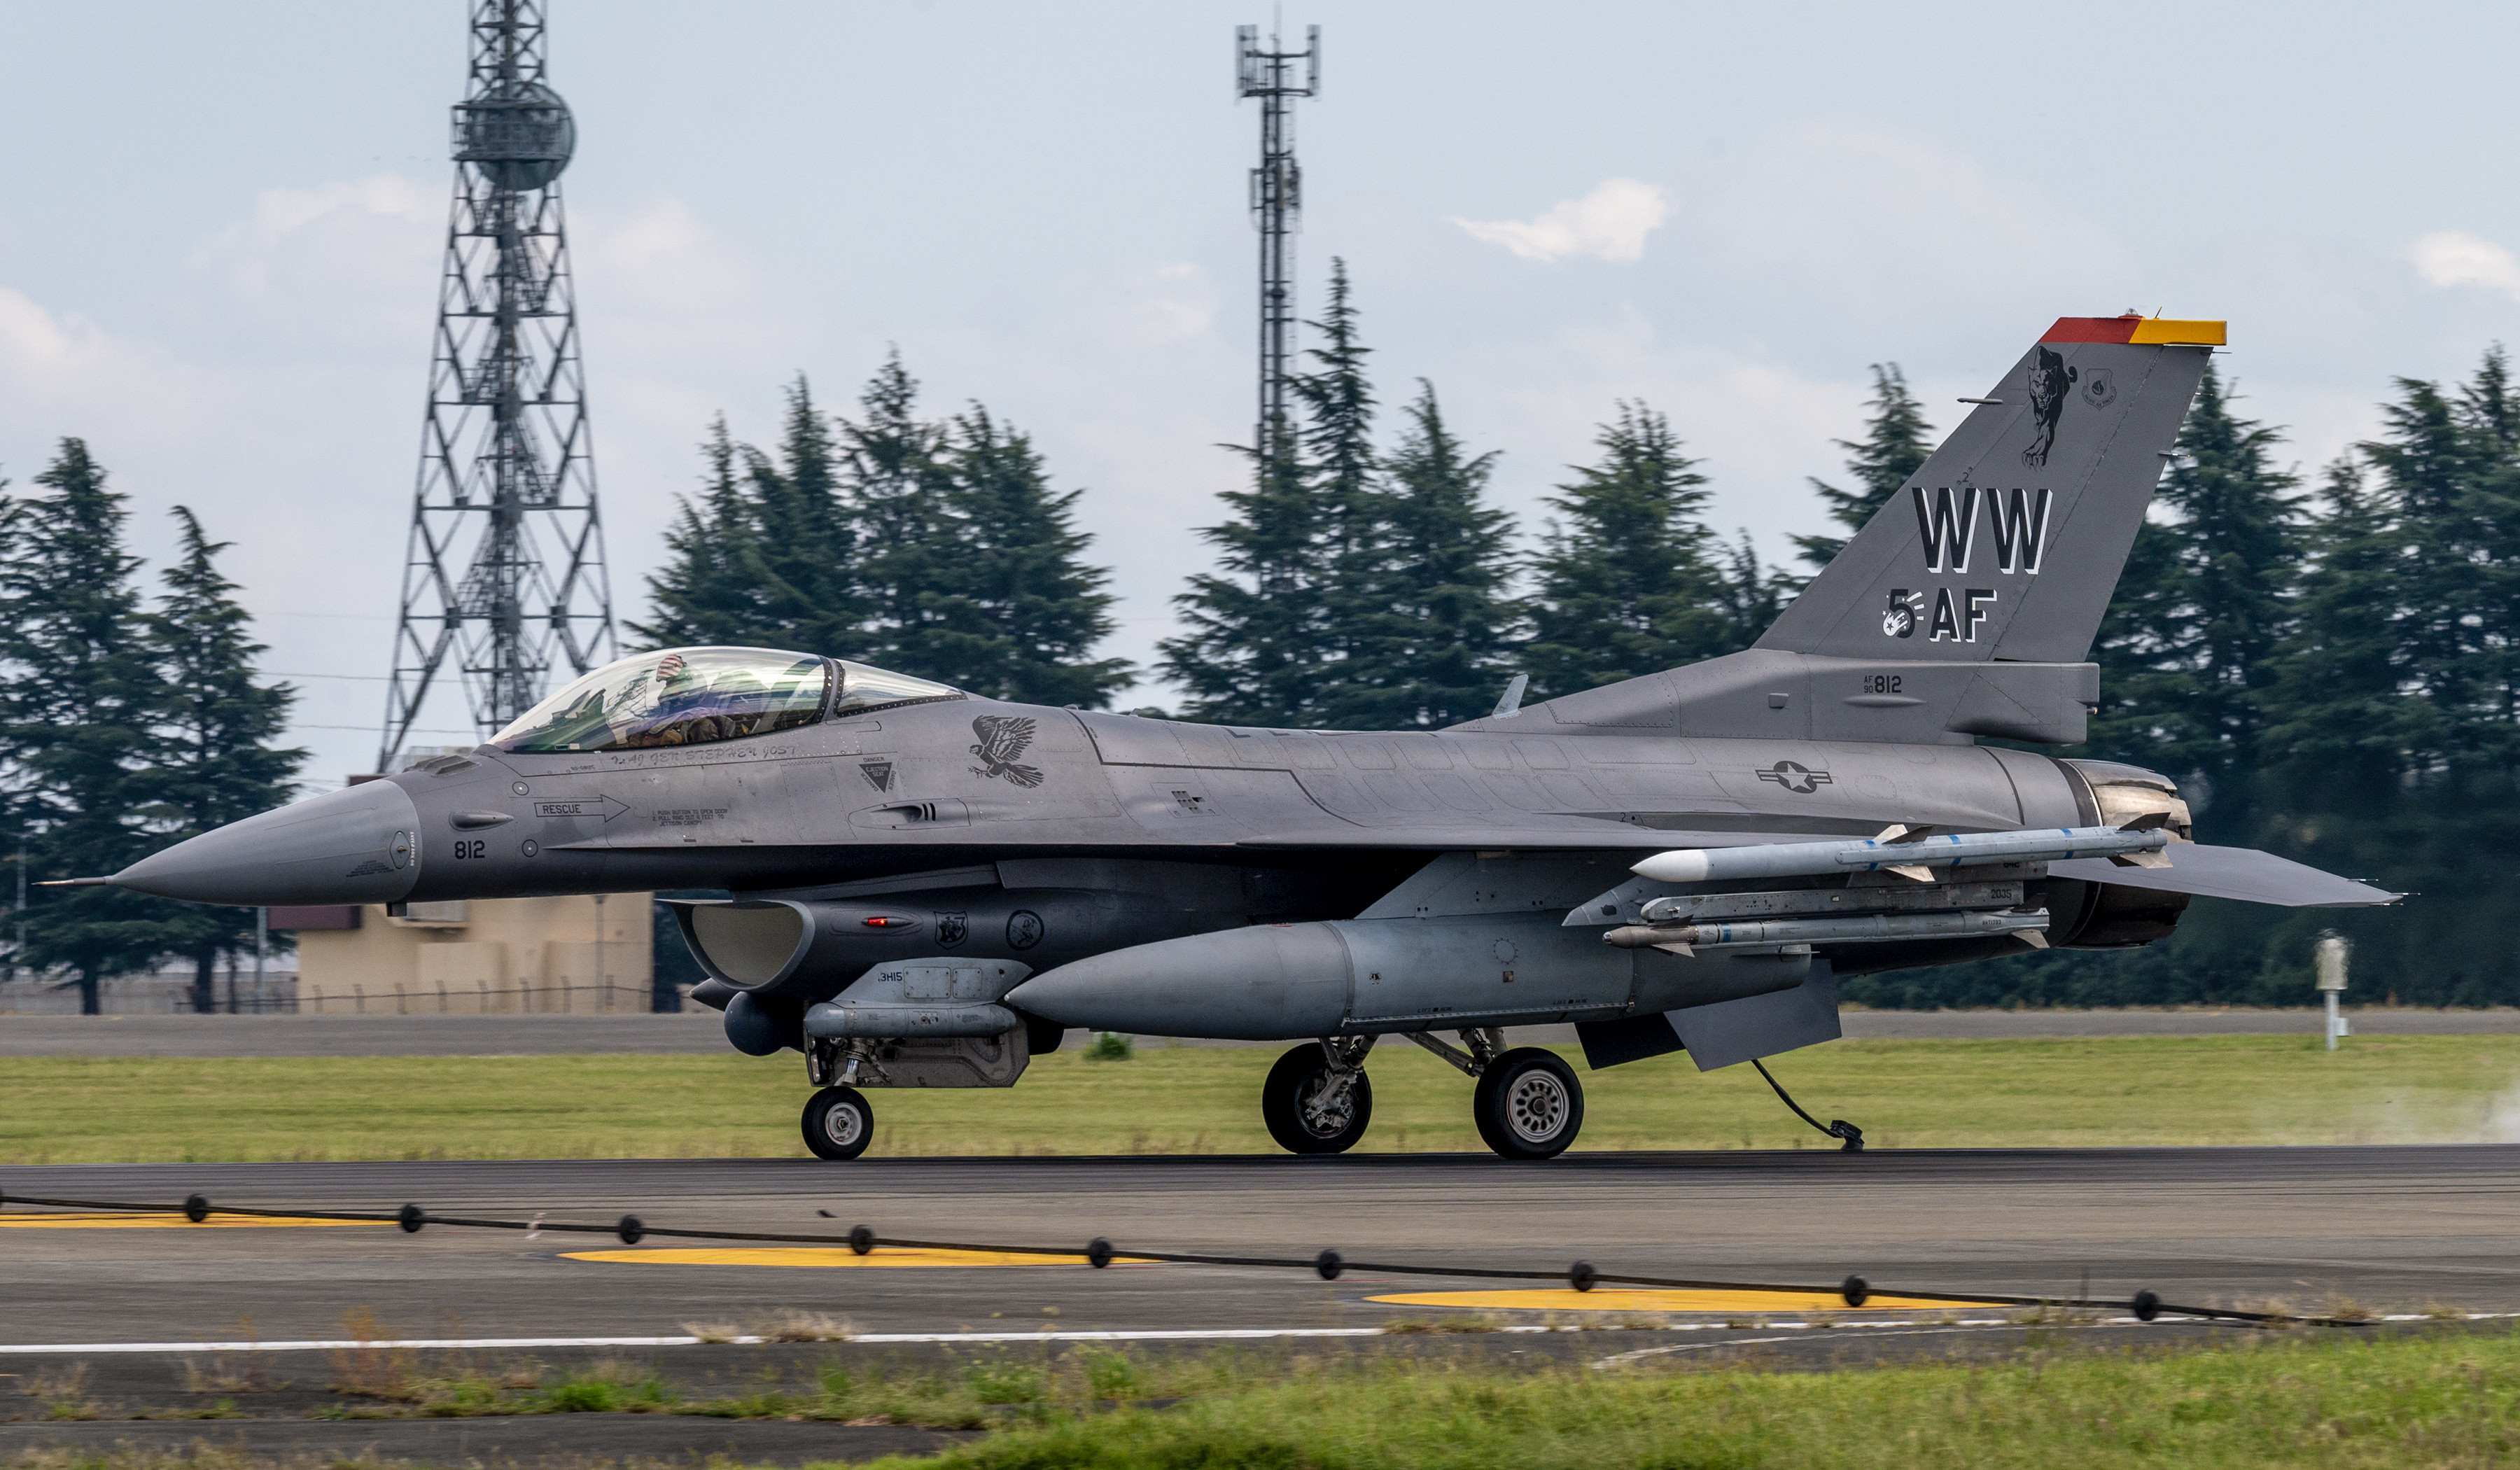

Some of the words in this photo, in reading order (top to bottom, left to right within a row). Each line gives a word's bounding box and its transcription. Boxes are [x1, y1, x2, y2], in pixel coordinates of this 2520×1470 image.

[1962, 472, 1969, 482] 2
[1912, 487, 2053, 575] WW
[1929, 588, 1997, 643] AF
[1875, 676, 1902, 693] 812
[763, 746, 796, 759] JOST
[860, 772, 878, 792] DANGER
[888, 770, 897, 790] DANGER
[542, 804, 582, 814] RESCUE
[1620, 812, 1625, 822] 2
[454, 840, 485, 859] 812
[1991, 889, 2012, 899] 2035
